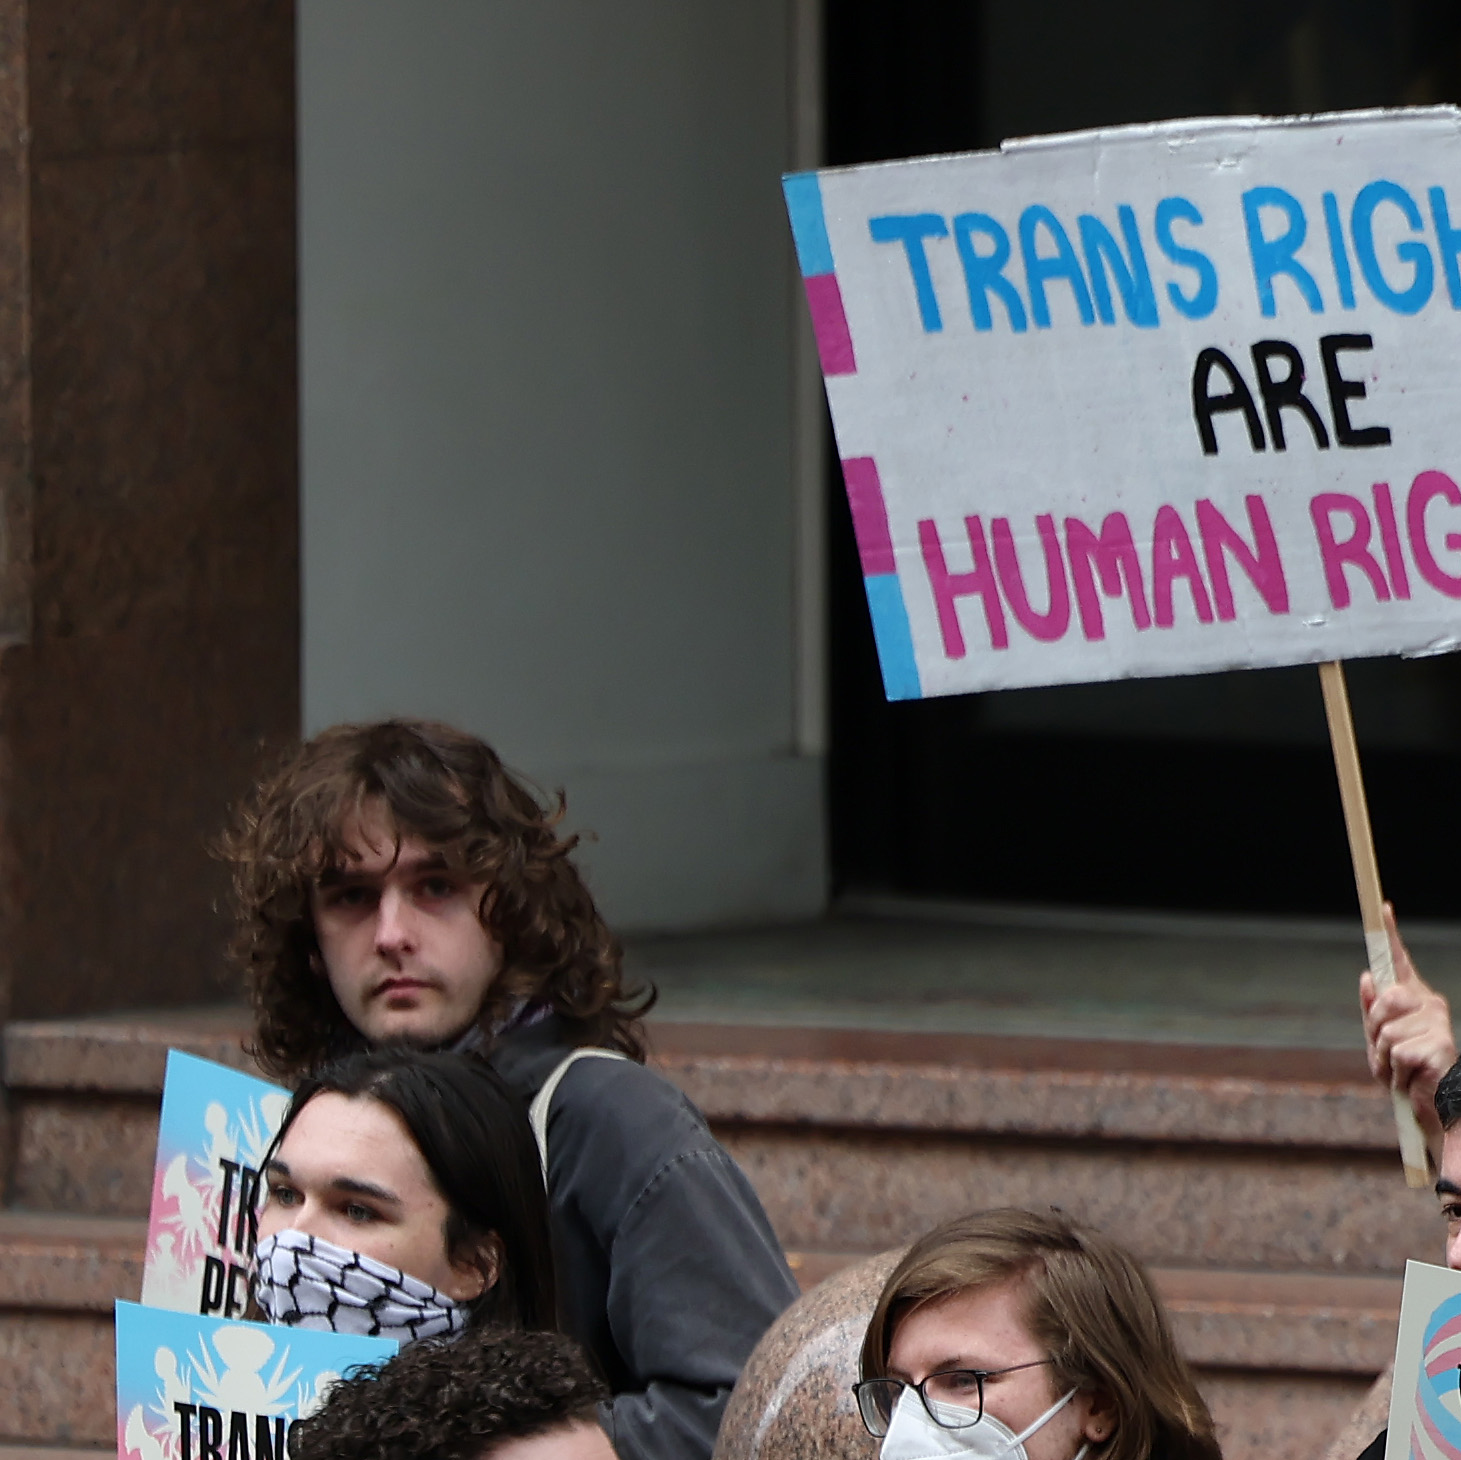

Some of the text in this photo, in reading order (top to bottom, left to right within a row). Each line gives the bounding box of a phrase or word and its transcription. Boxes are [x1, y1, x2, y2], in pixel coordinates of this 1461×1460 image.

[869, 197, 1218, 332] TRANS
[1191, 334, 1392, 455] ARE
[917, 493, 1290, 660] HUMAN
